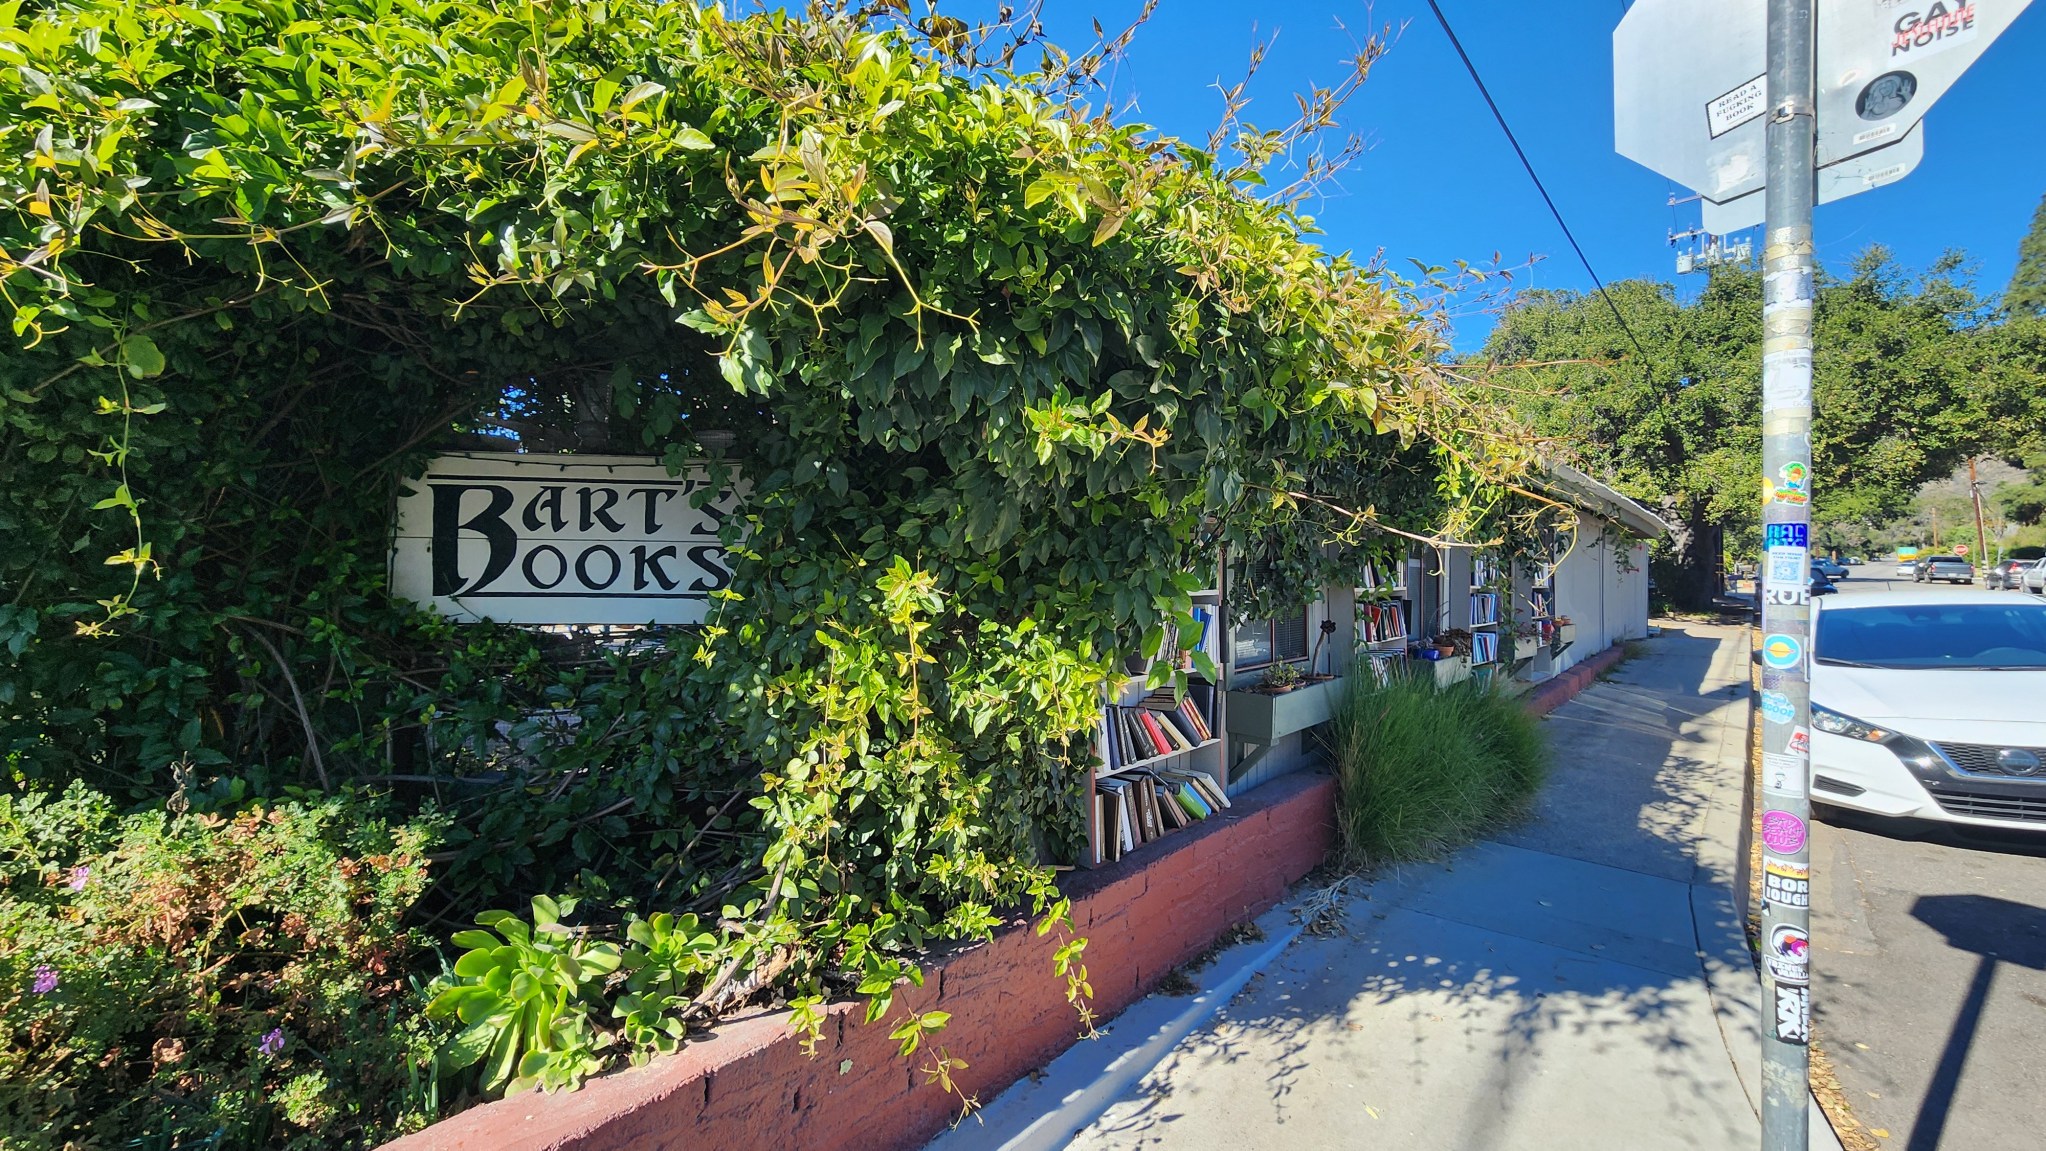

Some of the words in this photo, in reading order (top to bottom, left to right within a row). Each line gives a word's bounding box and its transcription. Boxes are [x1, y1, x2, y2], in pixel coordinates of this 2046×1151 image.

[1892, 14, 1974, 57] NOISE
[1719, 90, 1747, 107] READ
[1726, 102, 1754, 121] BOOK
